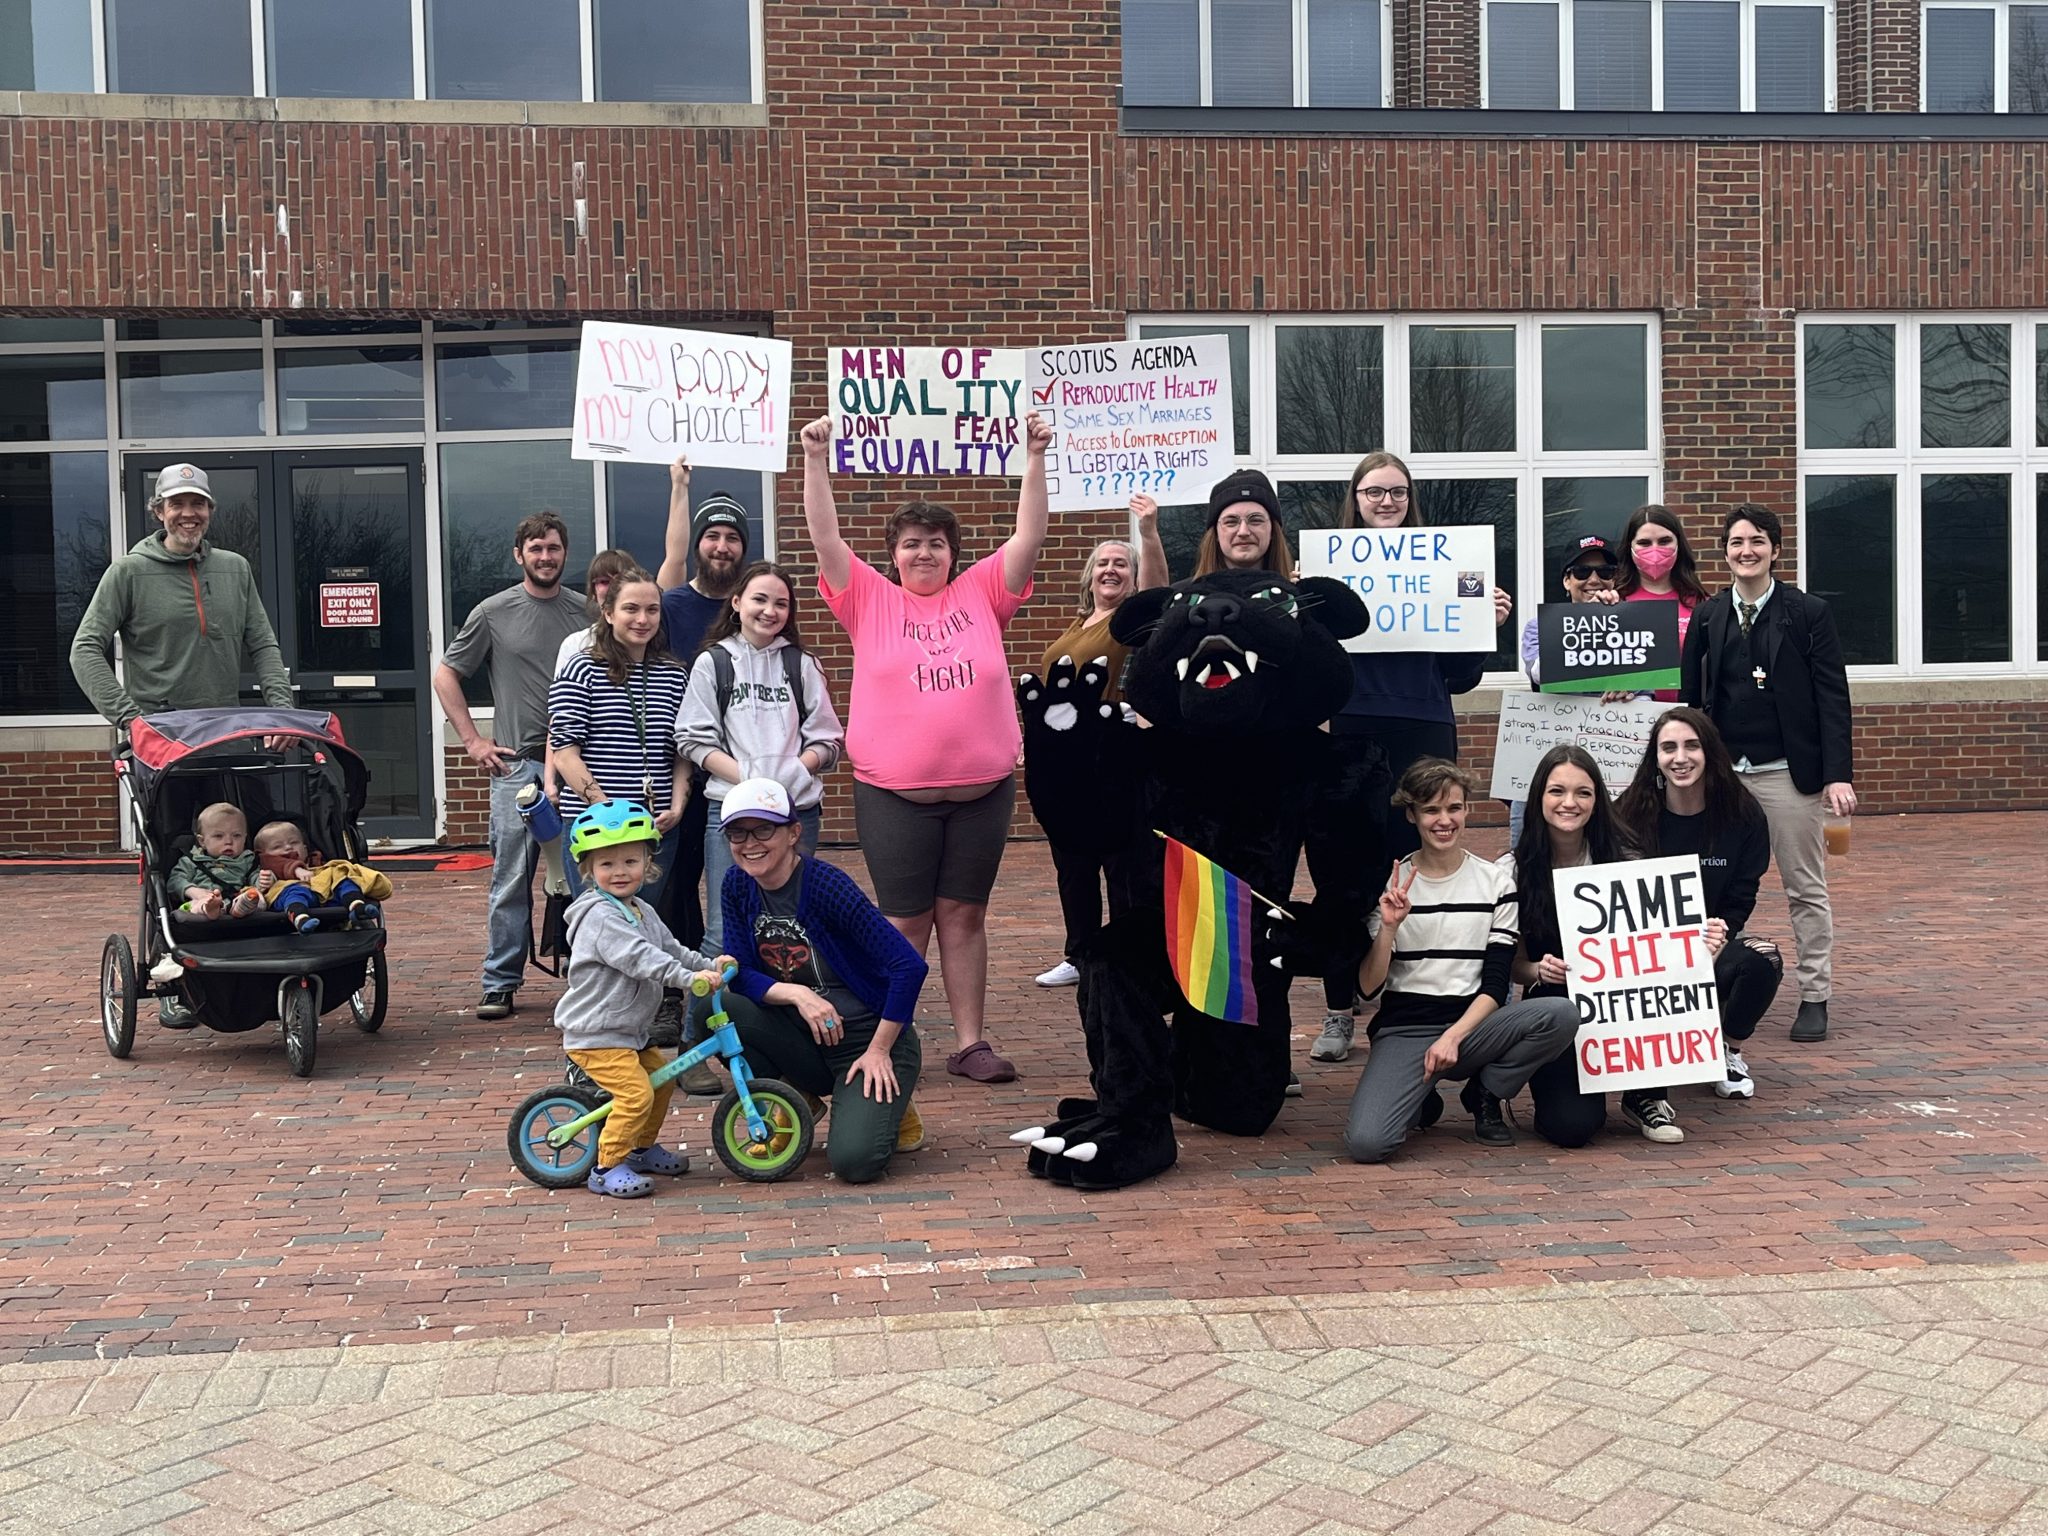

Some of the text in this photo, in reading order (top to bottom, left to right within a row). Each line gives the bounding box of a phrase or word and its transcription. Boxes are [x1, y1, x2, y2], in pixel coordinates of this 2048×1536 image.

[670, 342, 770, 407] BODY
[841, 348, 992, 379] MEN OF
[1041, 345, 1198, 377] SCOTUS AGENDA
[839, 377, 1022, 417] QUALITY
[1164, 374, 1218, 399] HEALTH
[647, 397, 775, 446] CHOICE!!
[842, 415, 1020, 445] DONT FEAR
[1063, 403, 1212, 430] SAME SEX MARRIAGES
[835, 438, 1015, 475] EQUALITY
[1067, 449, 1209, 474] LGBTQIA RIGHTS
[1328, 533, 1452, 564] POWER
[322, 586, 376, 597] EMERGENCY
[1342, 574, 1431, 594] TO THE
[327, 598, 372, 608] EXIT ONLY
[1376, 602, 1461, 632] OPLE
[902, 607, 974, 642] TOGETHER
[1562, 614, 1619, 633] BANS
[1562, 631, 1656, 650] OFF OUR
[1564, 648, 1647, 667] BODIES
[917, 659, 975, 693] FIGHT
[730, 682, 791, 707] PNHERS
[1507, 694, 1521, 709] I
[1526, 702, 1547, 712] am
[1634, 713, 1644, 724] I
[1540, 720, 1550, 730] I
[1554, 724, 1573, 732] am
[1577, 722, 1639, 741] tenacious
[1578, 737, 1648, 756] REPRODUC
[1511, 776, 1529, 789] For
[1700, 856, 1727, 866] ortion
[1573, 871, 1702, 934] SAME
[1578, 929, 1700, 983] SHIT
[1575, 981, 1716, 1025] DIFFERENT
[1580, 1027, 1720, 1076] CENTURY
